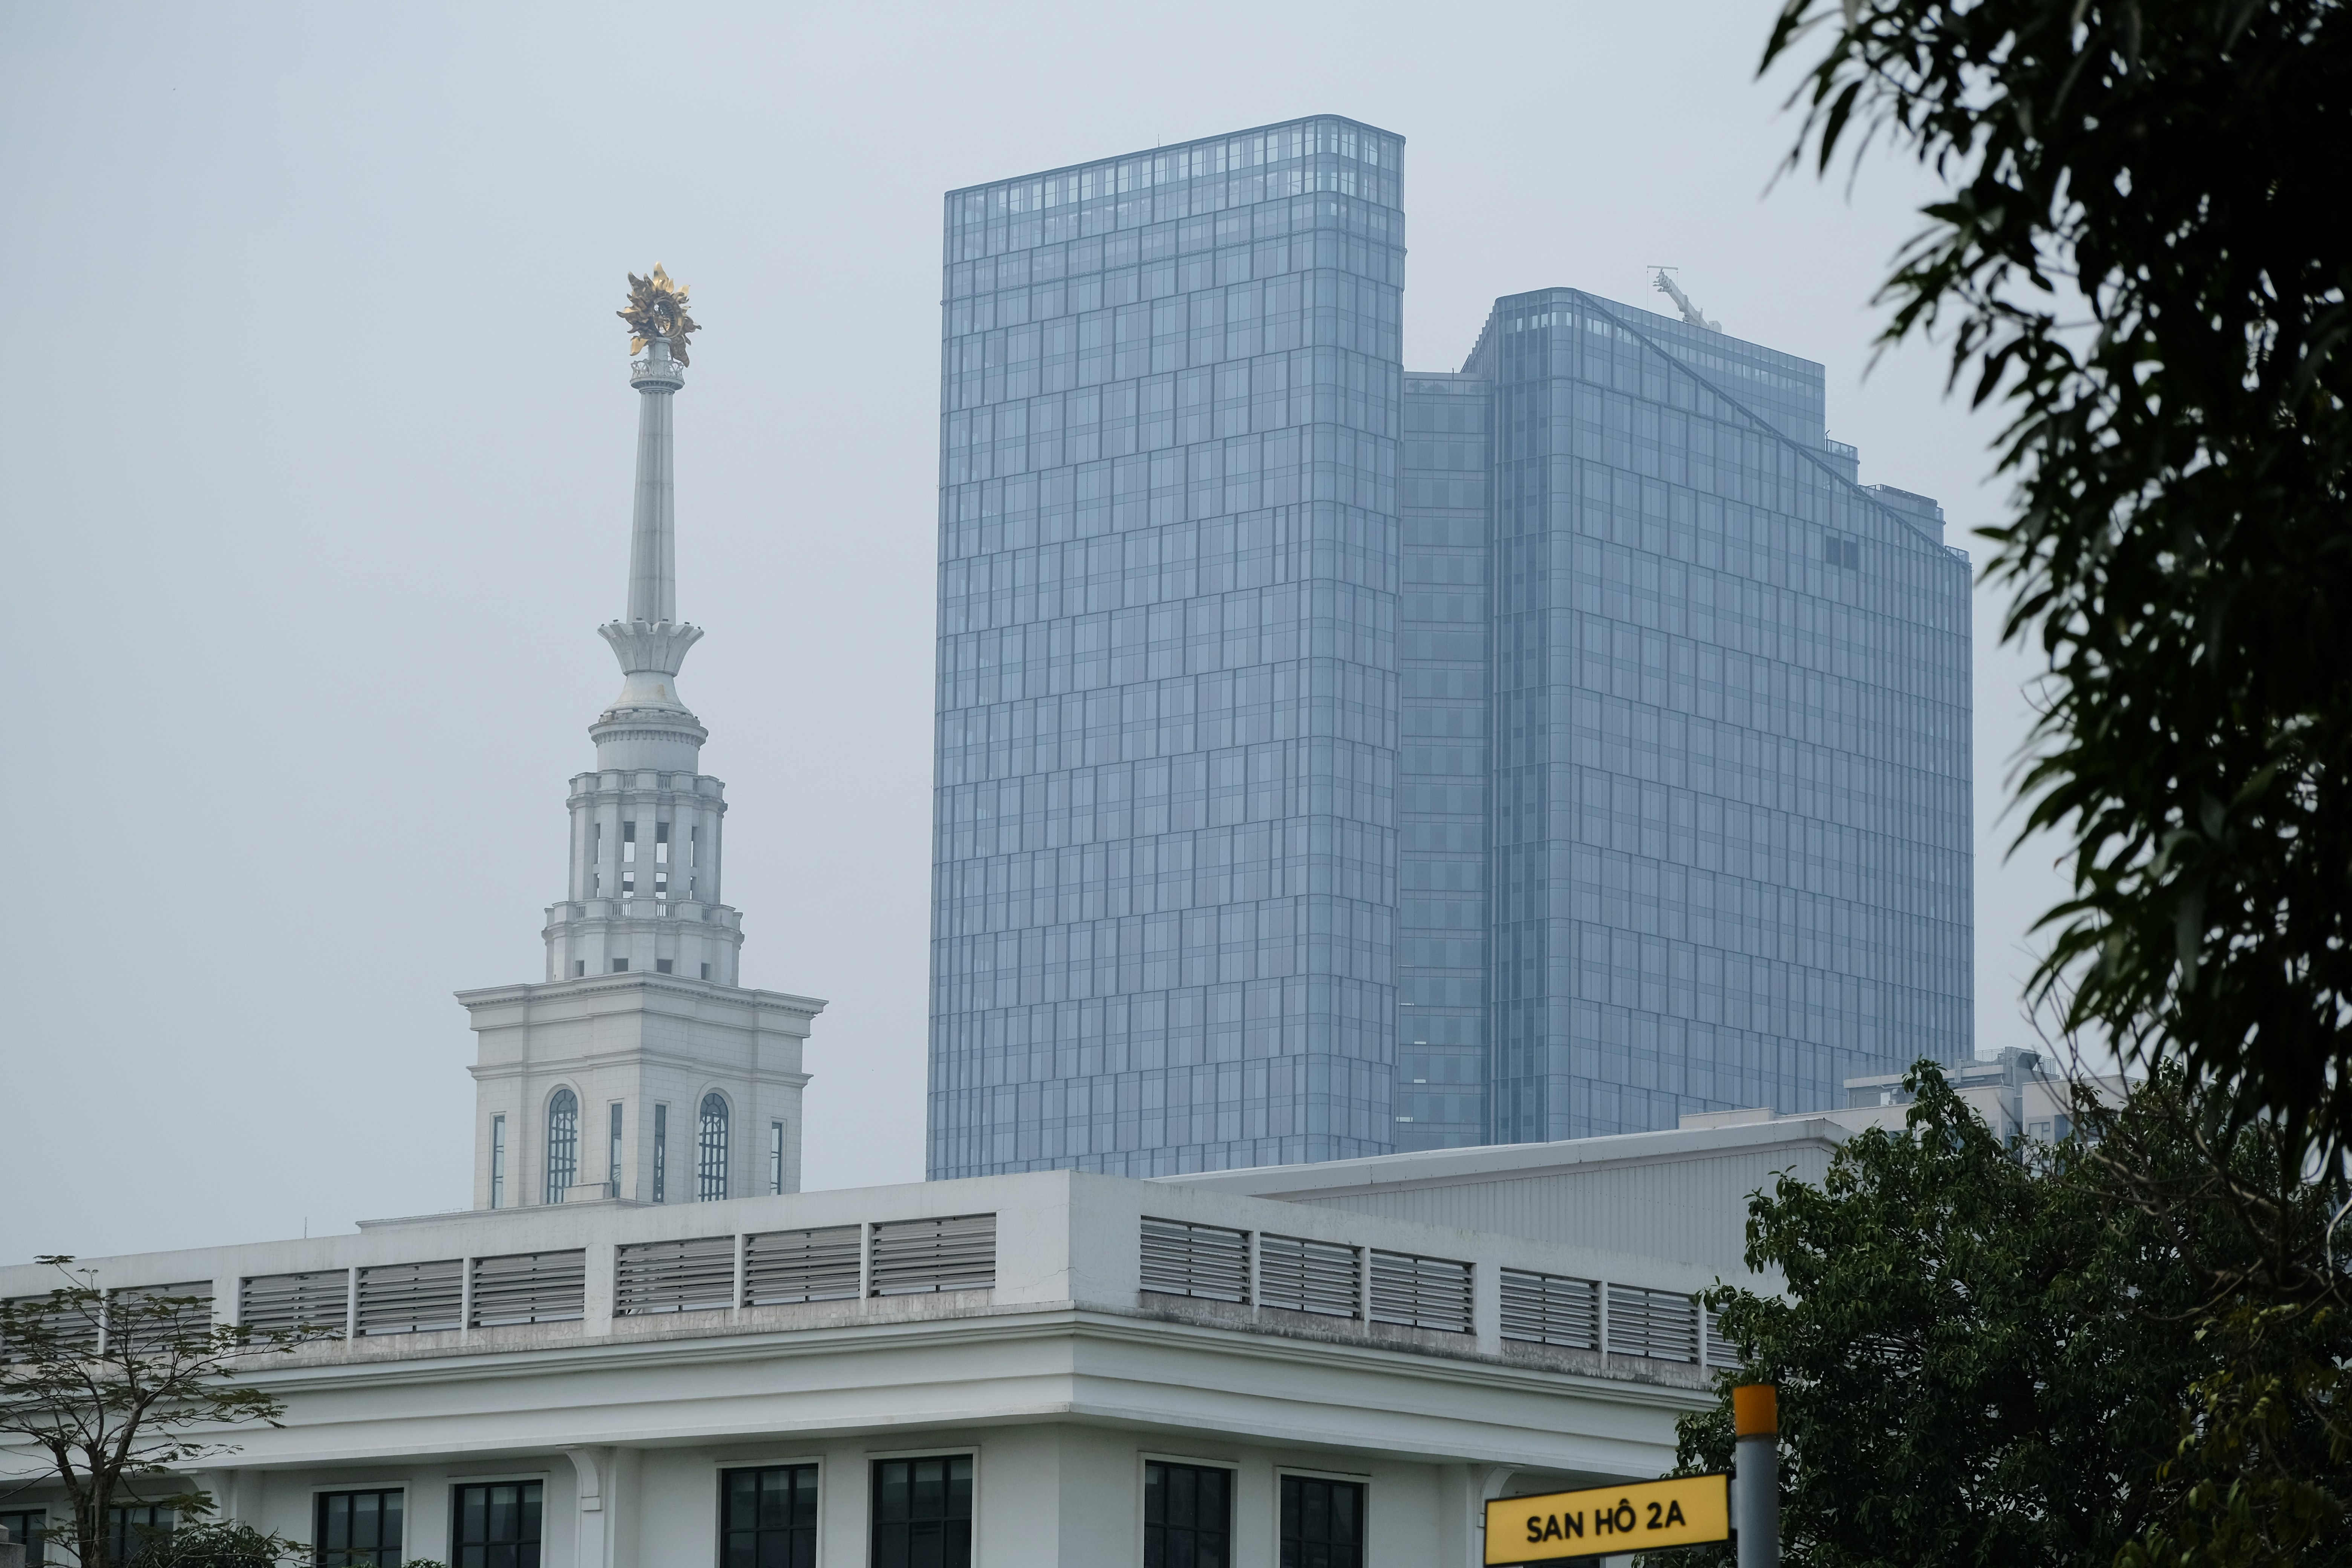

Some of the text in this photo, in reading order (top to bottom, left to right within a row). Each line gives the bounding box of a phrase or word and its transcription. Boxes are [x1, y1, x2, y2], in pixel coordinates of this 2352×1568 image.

[1527, 1498, 1686, 1543] SAN HÔ 2A
